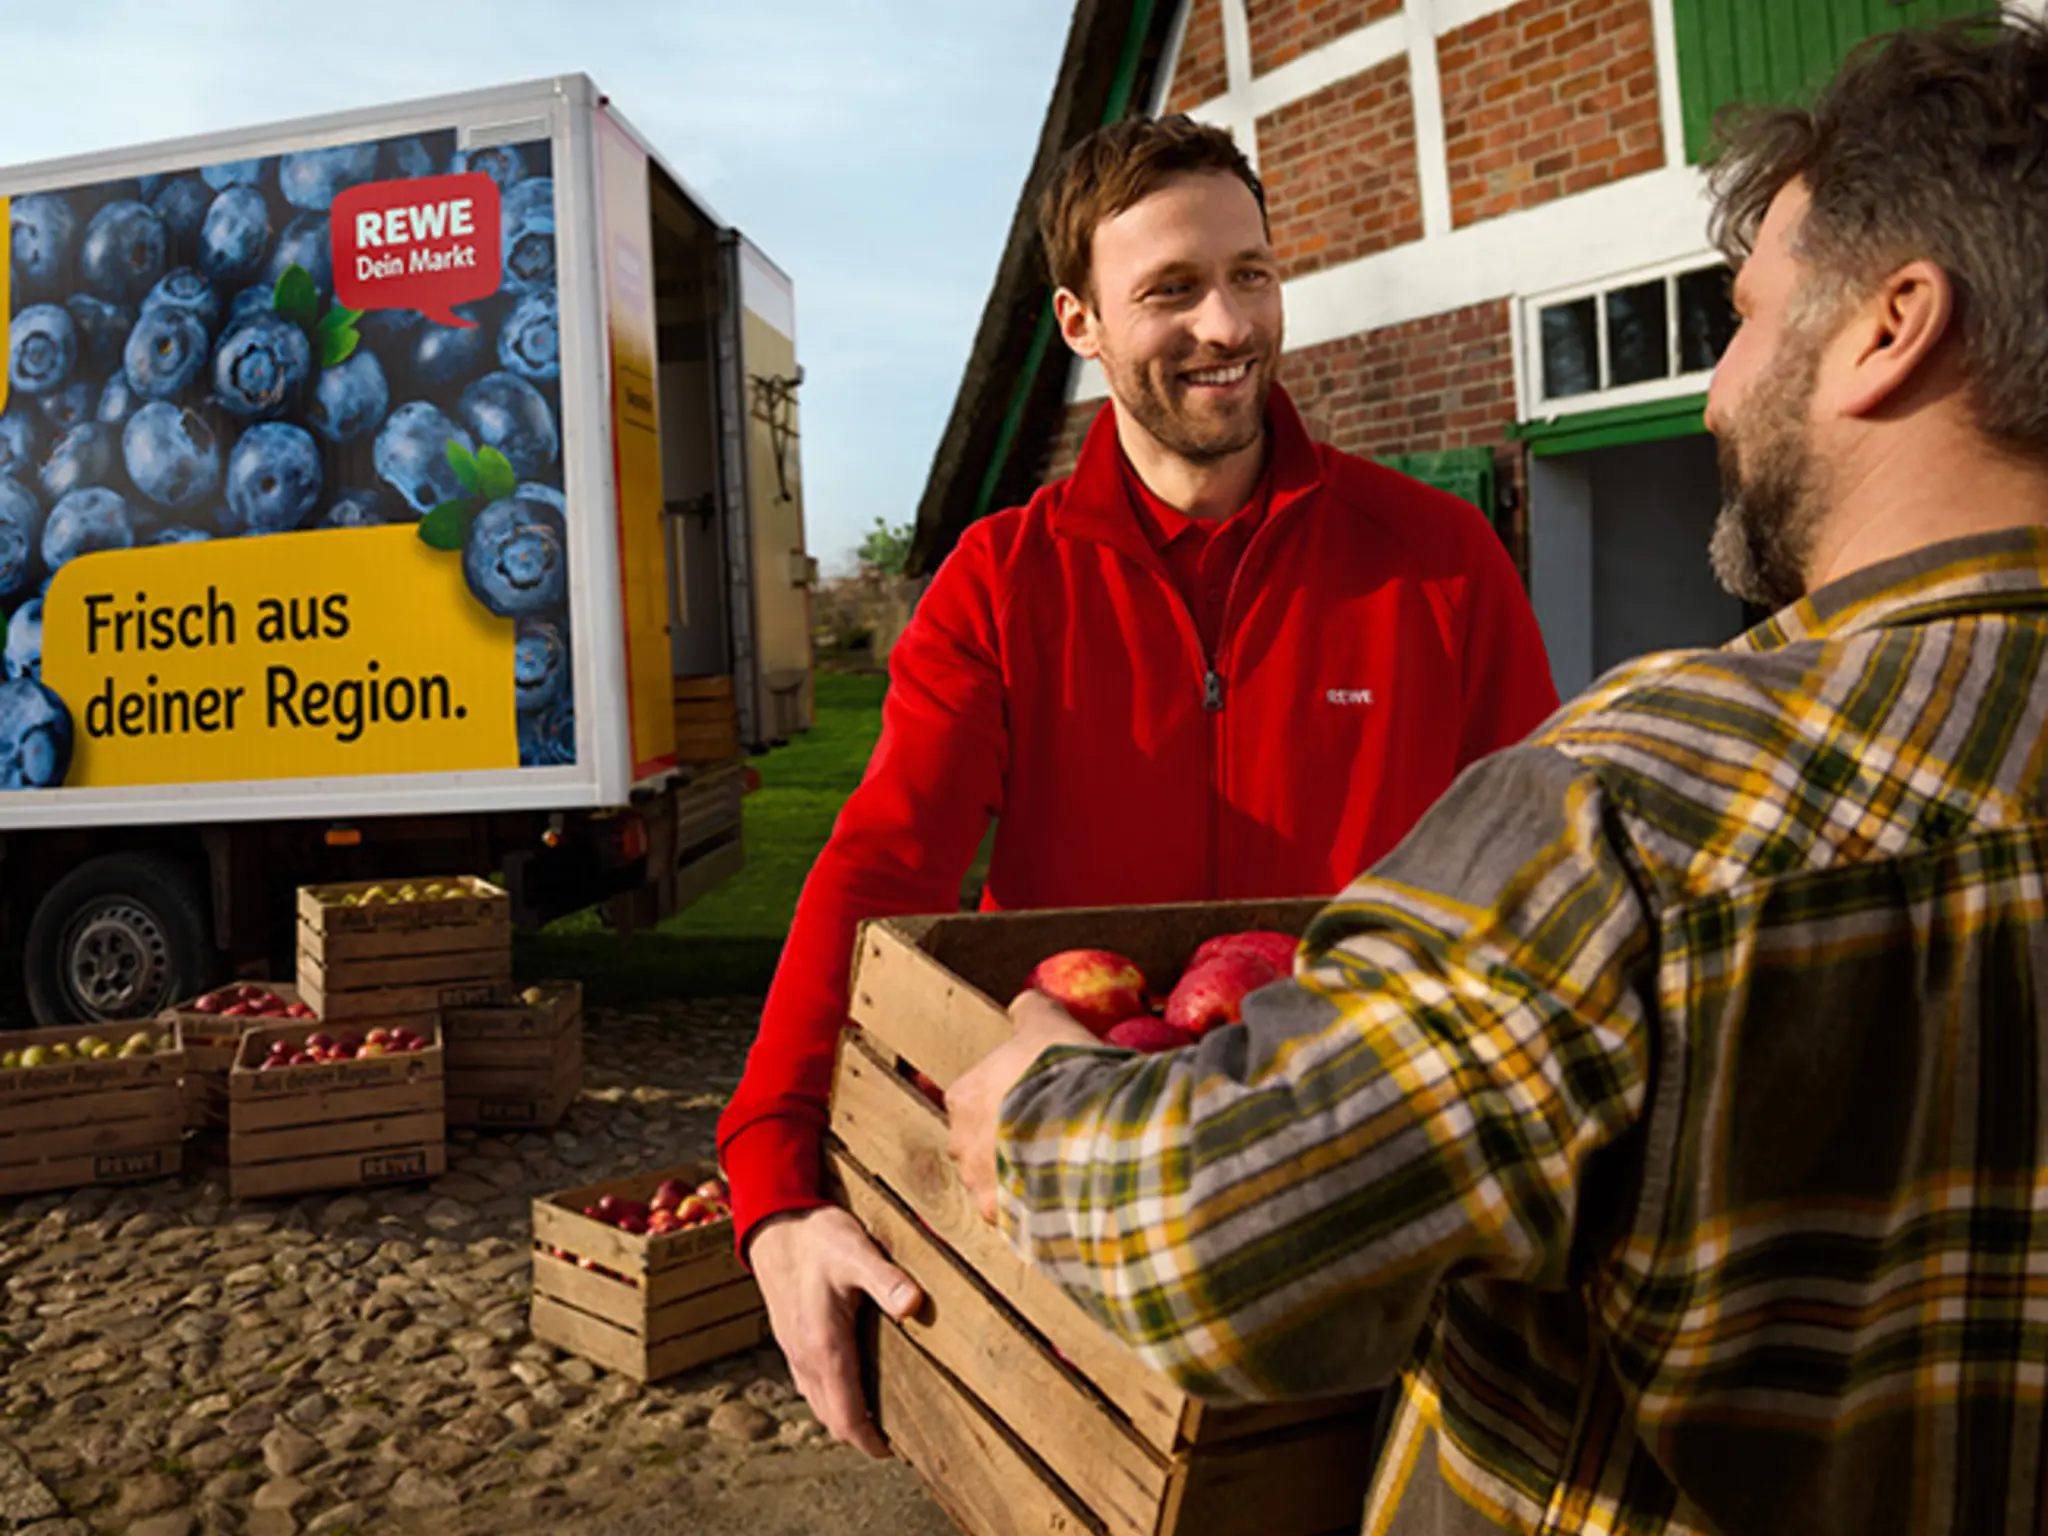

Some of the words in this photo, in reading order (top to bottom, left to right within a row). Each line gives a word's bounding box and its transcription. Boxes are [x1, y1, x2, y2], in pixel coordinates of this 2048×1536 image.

[355, 198, 475, 249] REWE
[355, 252, 404, 281] Dein
[408, 243, 476, 273] Markt
[84, 585, 236, 654] Frisch
[257, 594, 350, 643] aus
[85, 674, 244, 738] deiner
[266, 660, 467, 743] Region.
